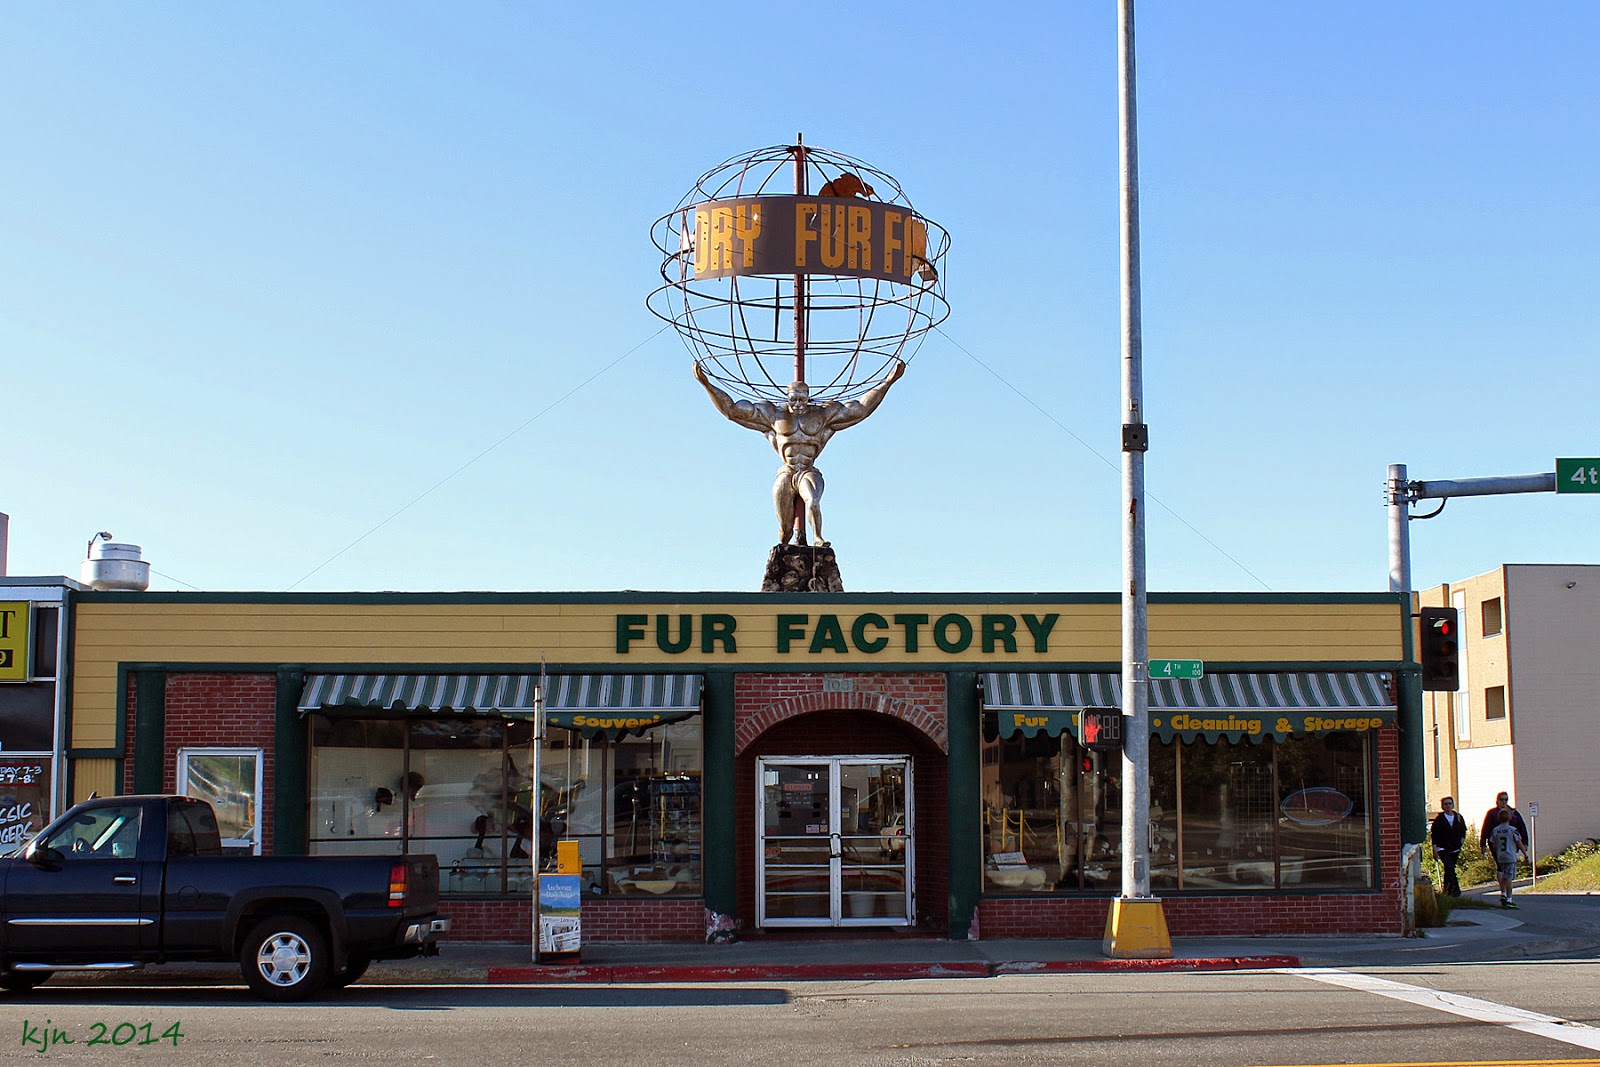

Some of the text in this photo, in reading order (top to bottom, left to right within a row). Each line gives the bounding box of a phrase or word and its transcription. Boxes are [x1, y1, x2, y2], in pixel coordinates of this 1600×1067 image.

[795, 203, 872, 270] FUR
[615, 612, 1061, 654] FUR FACTORY
[1013, 713, 1383, 735] Fur Cleaning & Storage
[0, 821, 34, 845] GERS
[1499, 836, 1508, 852] 3
